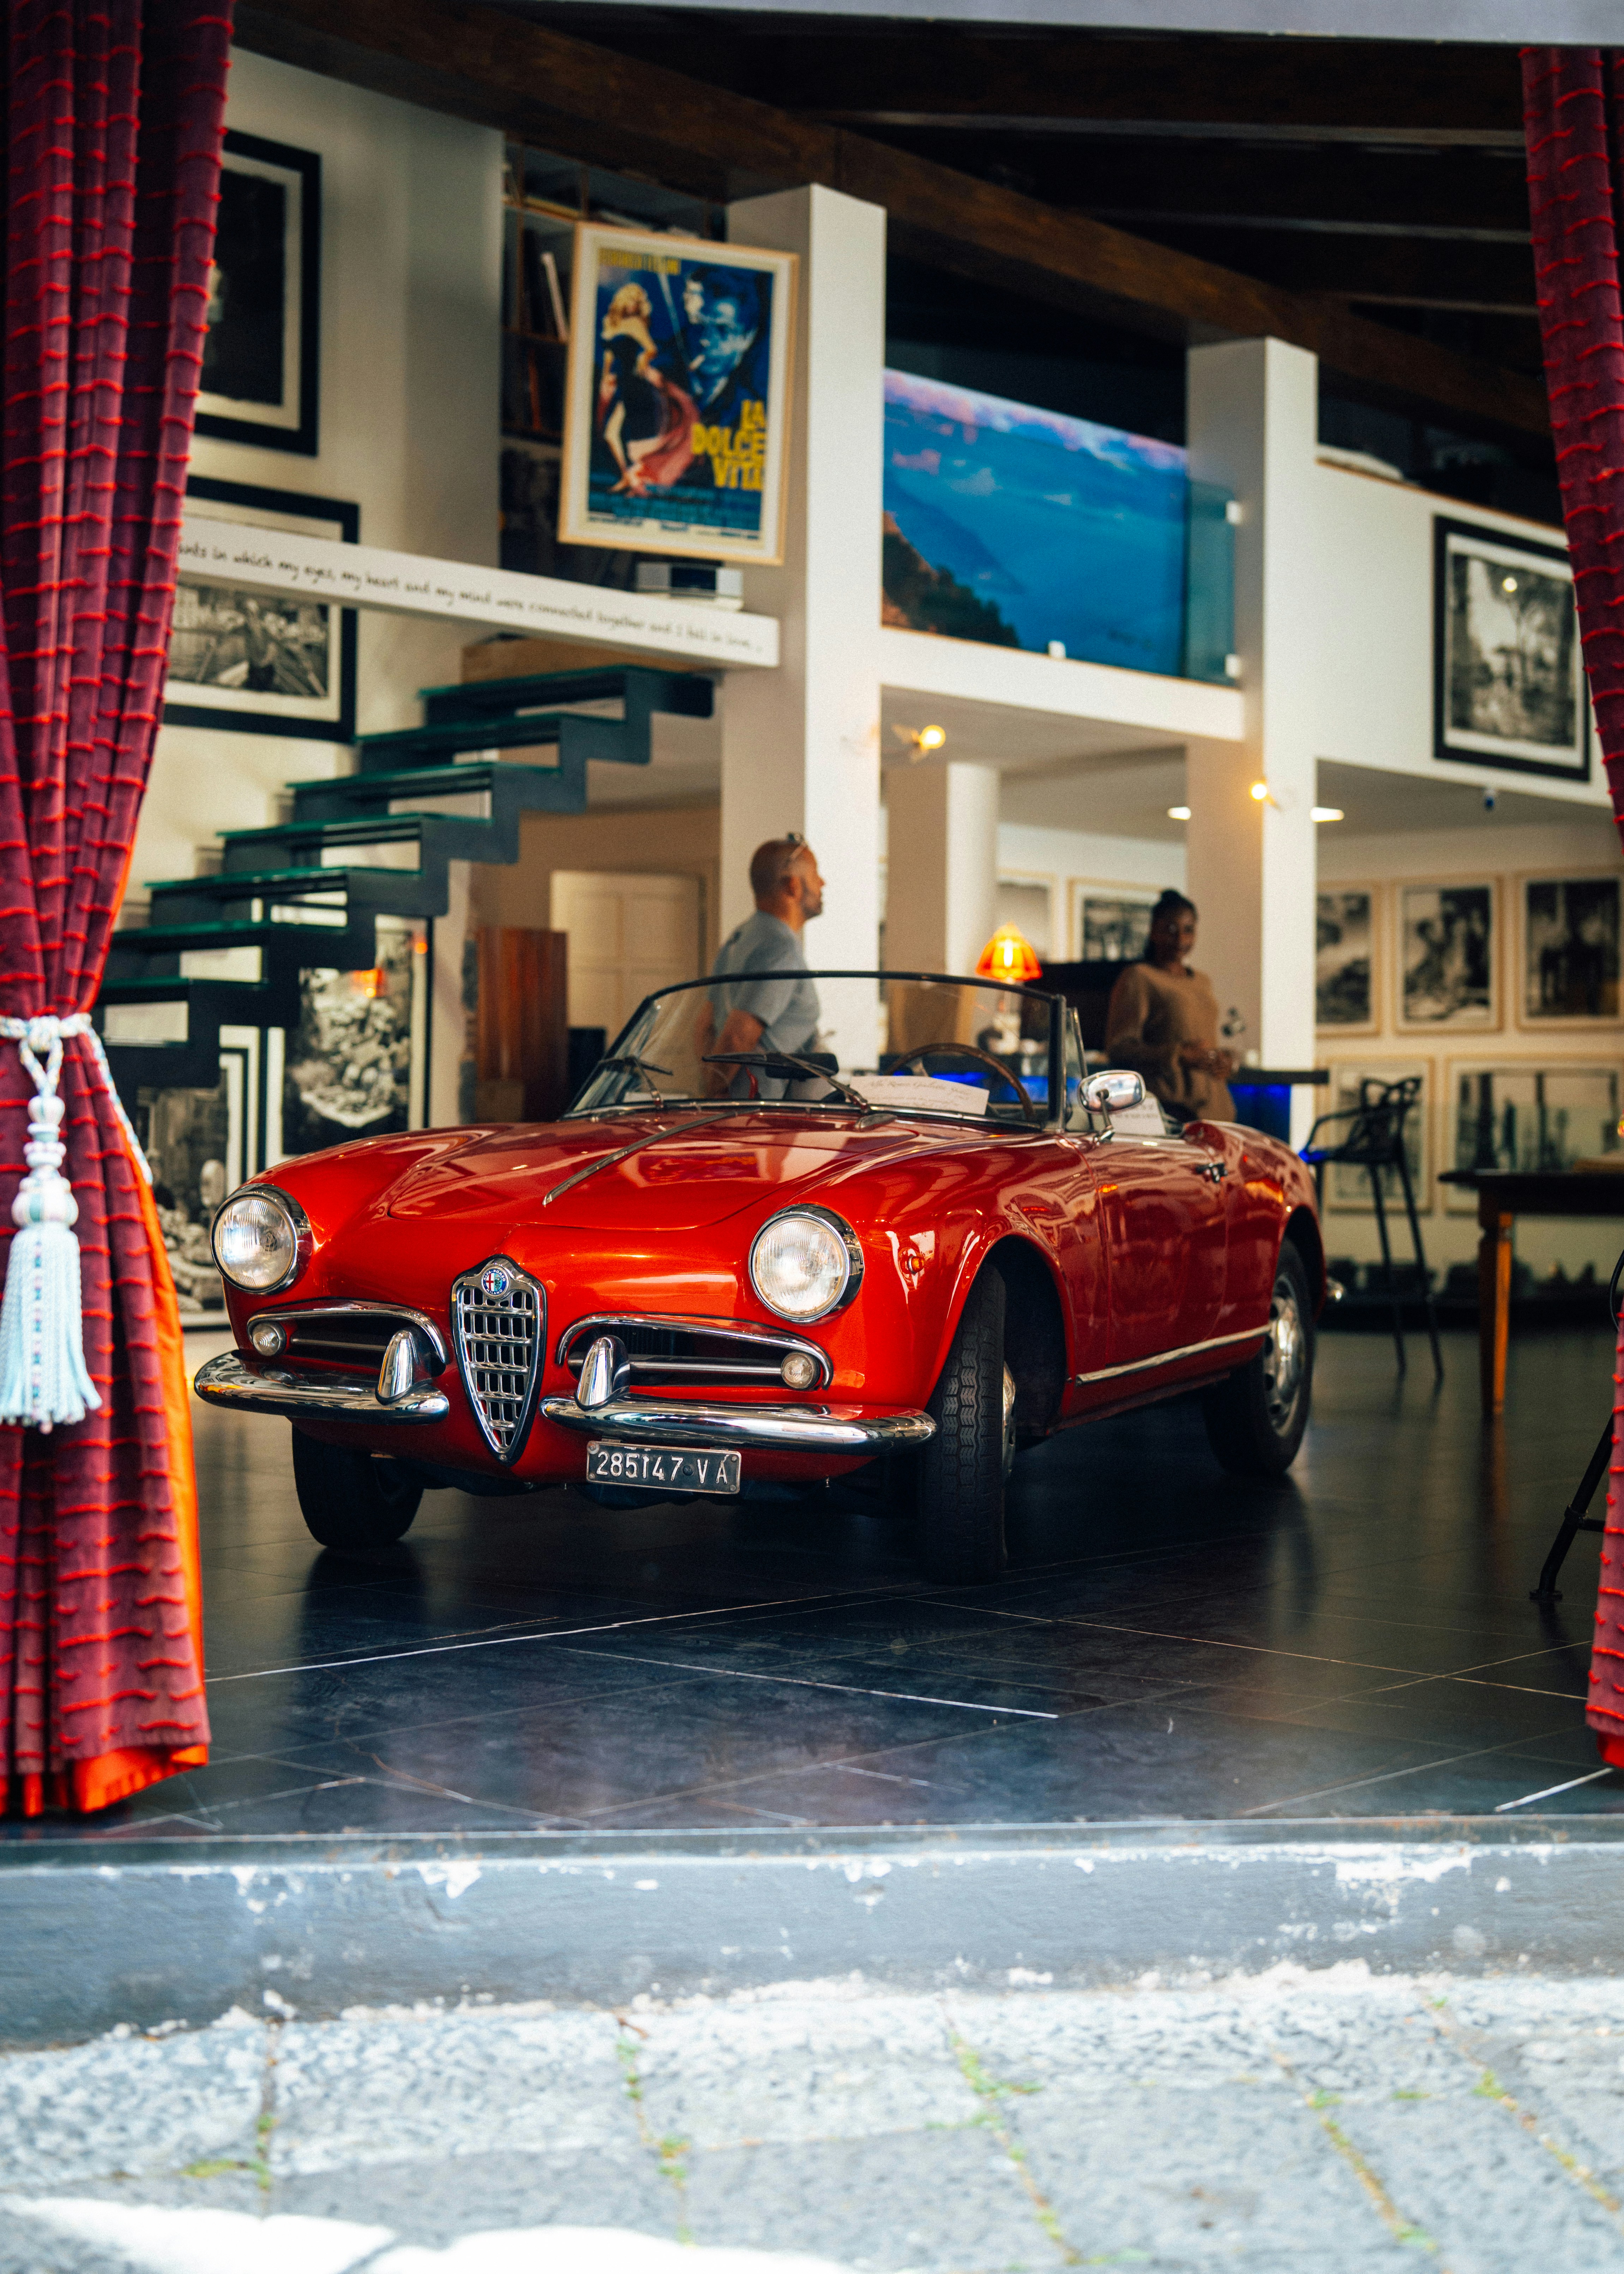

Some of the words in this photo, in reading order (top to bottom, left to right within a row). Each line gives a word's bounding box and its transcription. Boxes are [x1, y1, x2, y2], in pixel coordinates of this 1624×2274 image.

[742, 399, 765, 429] LA
[692, 423, 765, 459] DOLCE
[713, 456, 764, 491] VITA
[212, 546, 227, 560] in
[233, 551, 273, 568] which
[278, 561, 299, 581] my
[341, 571, 361, 591] my
[365, 571, 399, 588] heart
[405, 581, 429, 594] and
[435, 586, 454, 607] my
[459, 590, 492, 604] mind
[529, 603, 593, 622] connected
[596, 610, 645, 631] together
[649, 621, 672, 634] and
[596, 1451, 684, 1481] 285147
